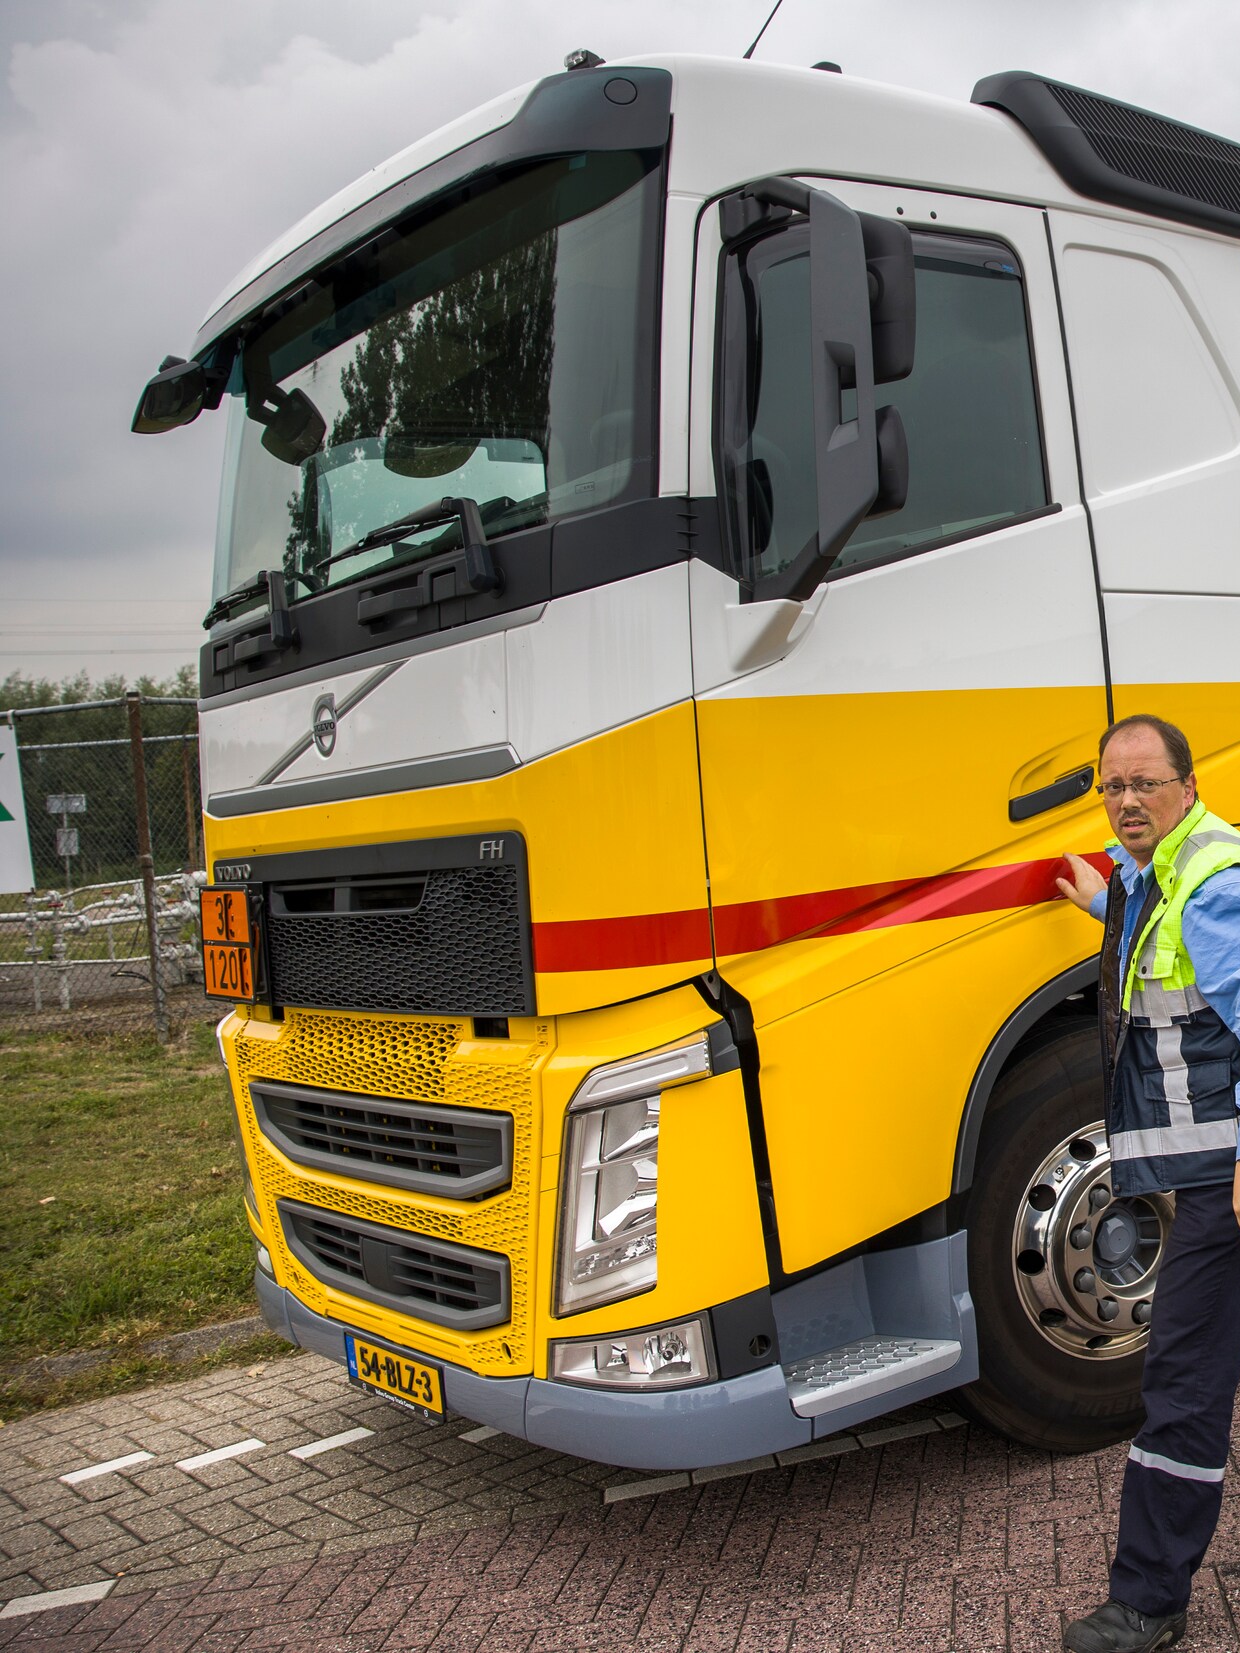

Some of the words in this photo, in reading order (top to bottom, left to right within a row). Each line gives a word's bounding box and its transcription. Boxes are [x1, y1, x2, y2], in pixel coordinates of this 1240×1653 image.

[480, 839, 505, 860] FH
[215, 864, 251, 881] VOLVO
[360, 1346, 433, 1403] 54-BLZ-3
